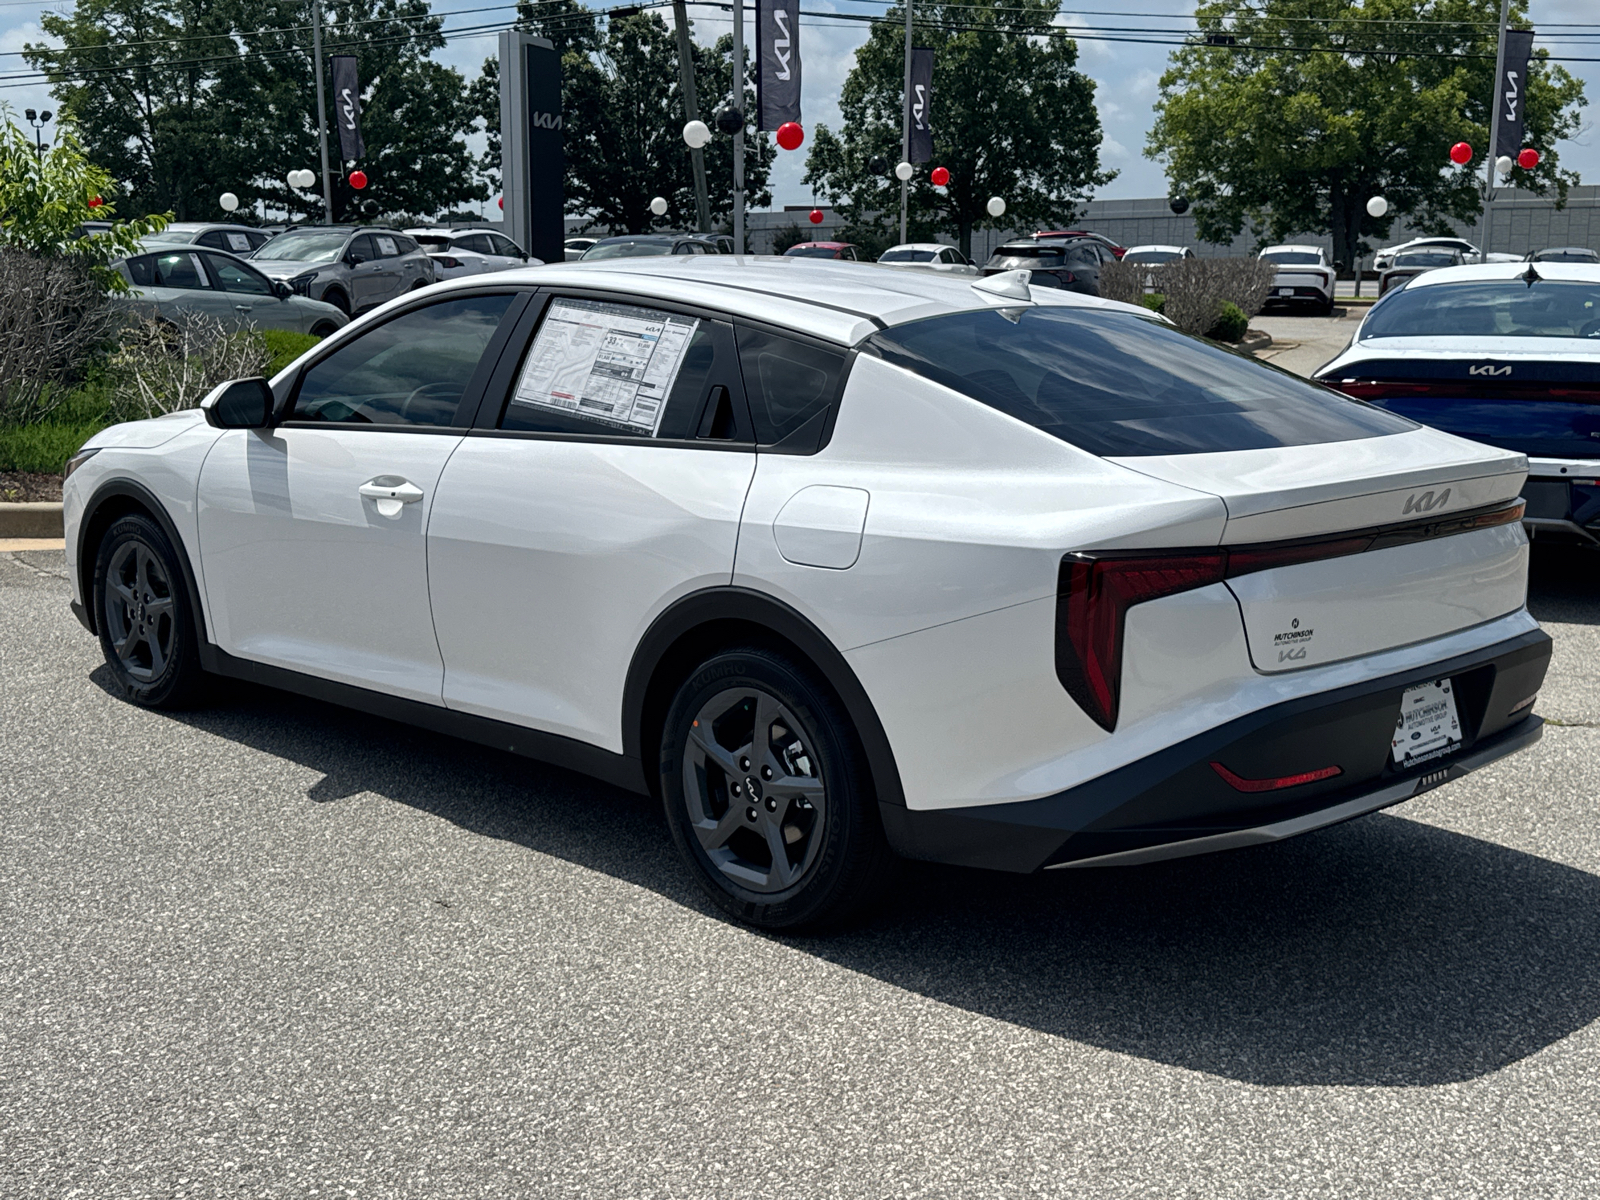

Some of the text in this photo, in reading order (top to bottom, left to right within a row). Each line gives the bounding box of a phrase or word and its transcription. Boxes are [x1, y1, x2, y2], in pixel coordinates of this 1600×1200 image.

[774, 9, 791, 81] KIA
[341, 88, 356, 130] KIA
[913, 84, 925, 130] KIA
[1505, 71, 1519, 121] KIA
[533, 111, 563, 131] KIA
[1469, 365, 1512, 376] KIA
[1402, 488, 1451, 515] KIA
[1274, 629, 1314, 641] HUTCHINSON
[692, 662, 746, 691] KUMHO
[1405, 699, 1448, 723] HUTCHINSON
